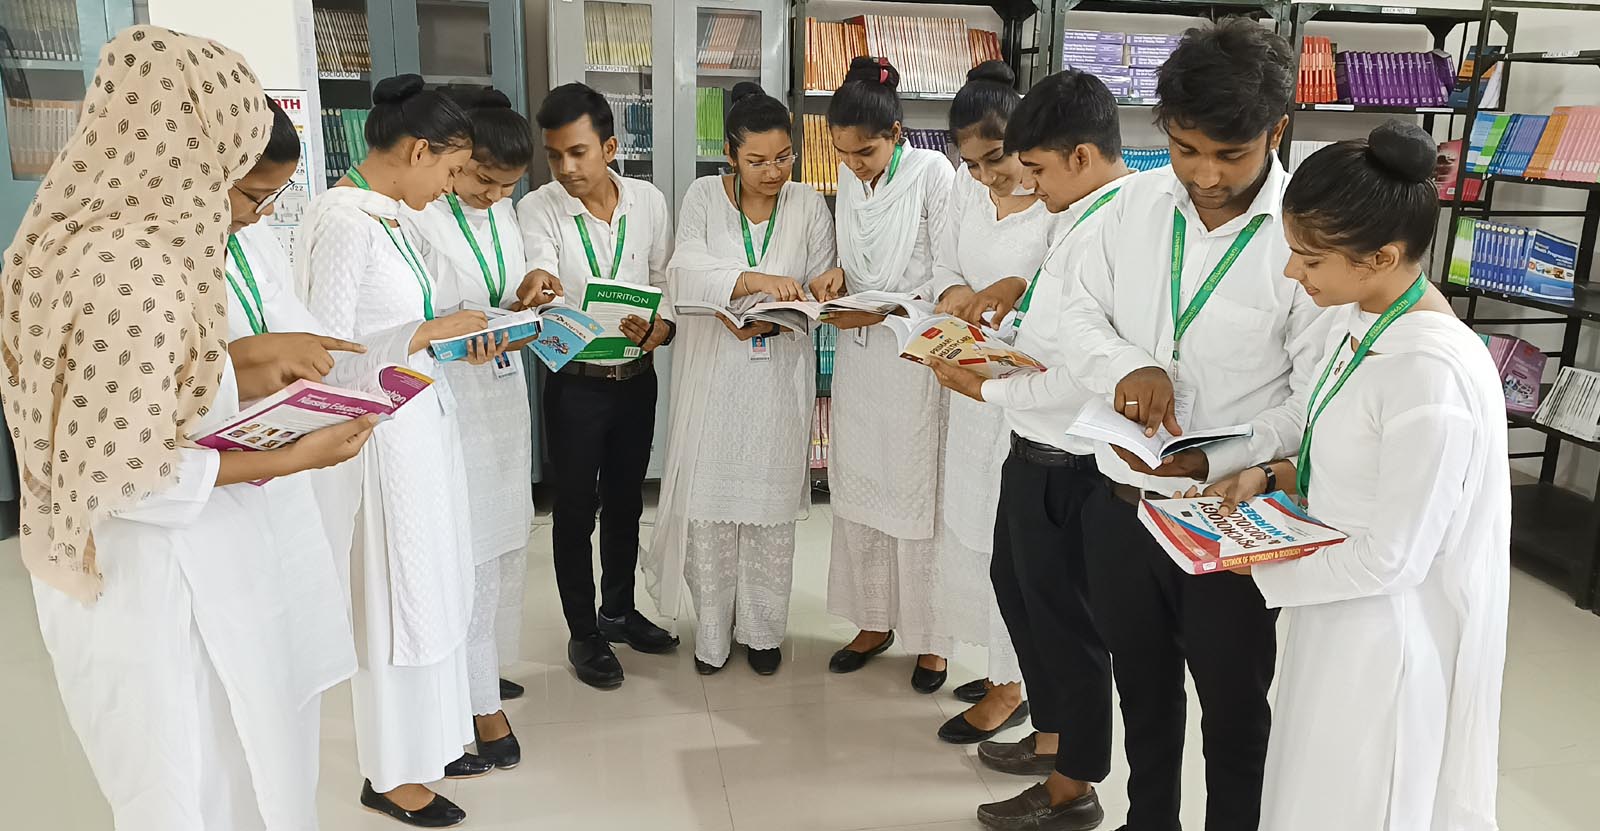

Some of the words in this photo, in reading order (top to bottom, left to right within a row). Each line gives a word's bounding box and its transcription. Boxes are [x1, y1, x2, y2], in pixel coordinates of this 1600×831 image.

[597, 290, 649, 304] NUTRITION
[930, 337, 953, 355] PRIMARY
[297, 396, 331, 410] Nursing
[328, 402, 368, 415] Education
[1198, 502, 1260, 549] PSYCHOLOGY
[1243, 556, 1249, 564] OF
[1249, 552, 1274, 563] PSYCHOLOGY
